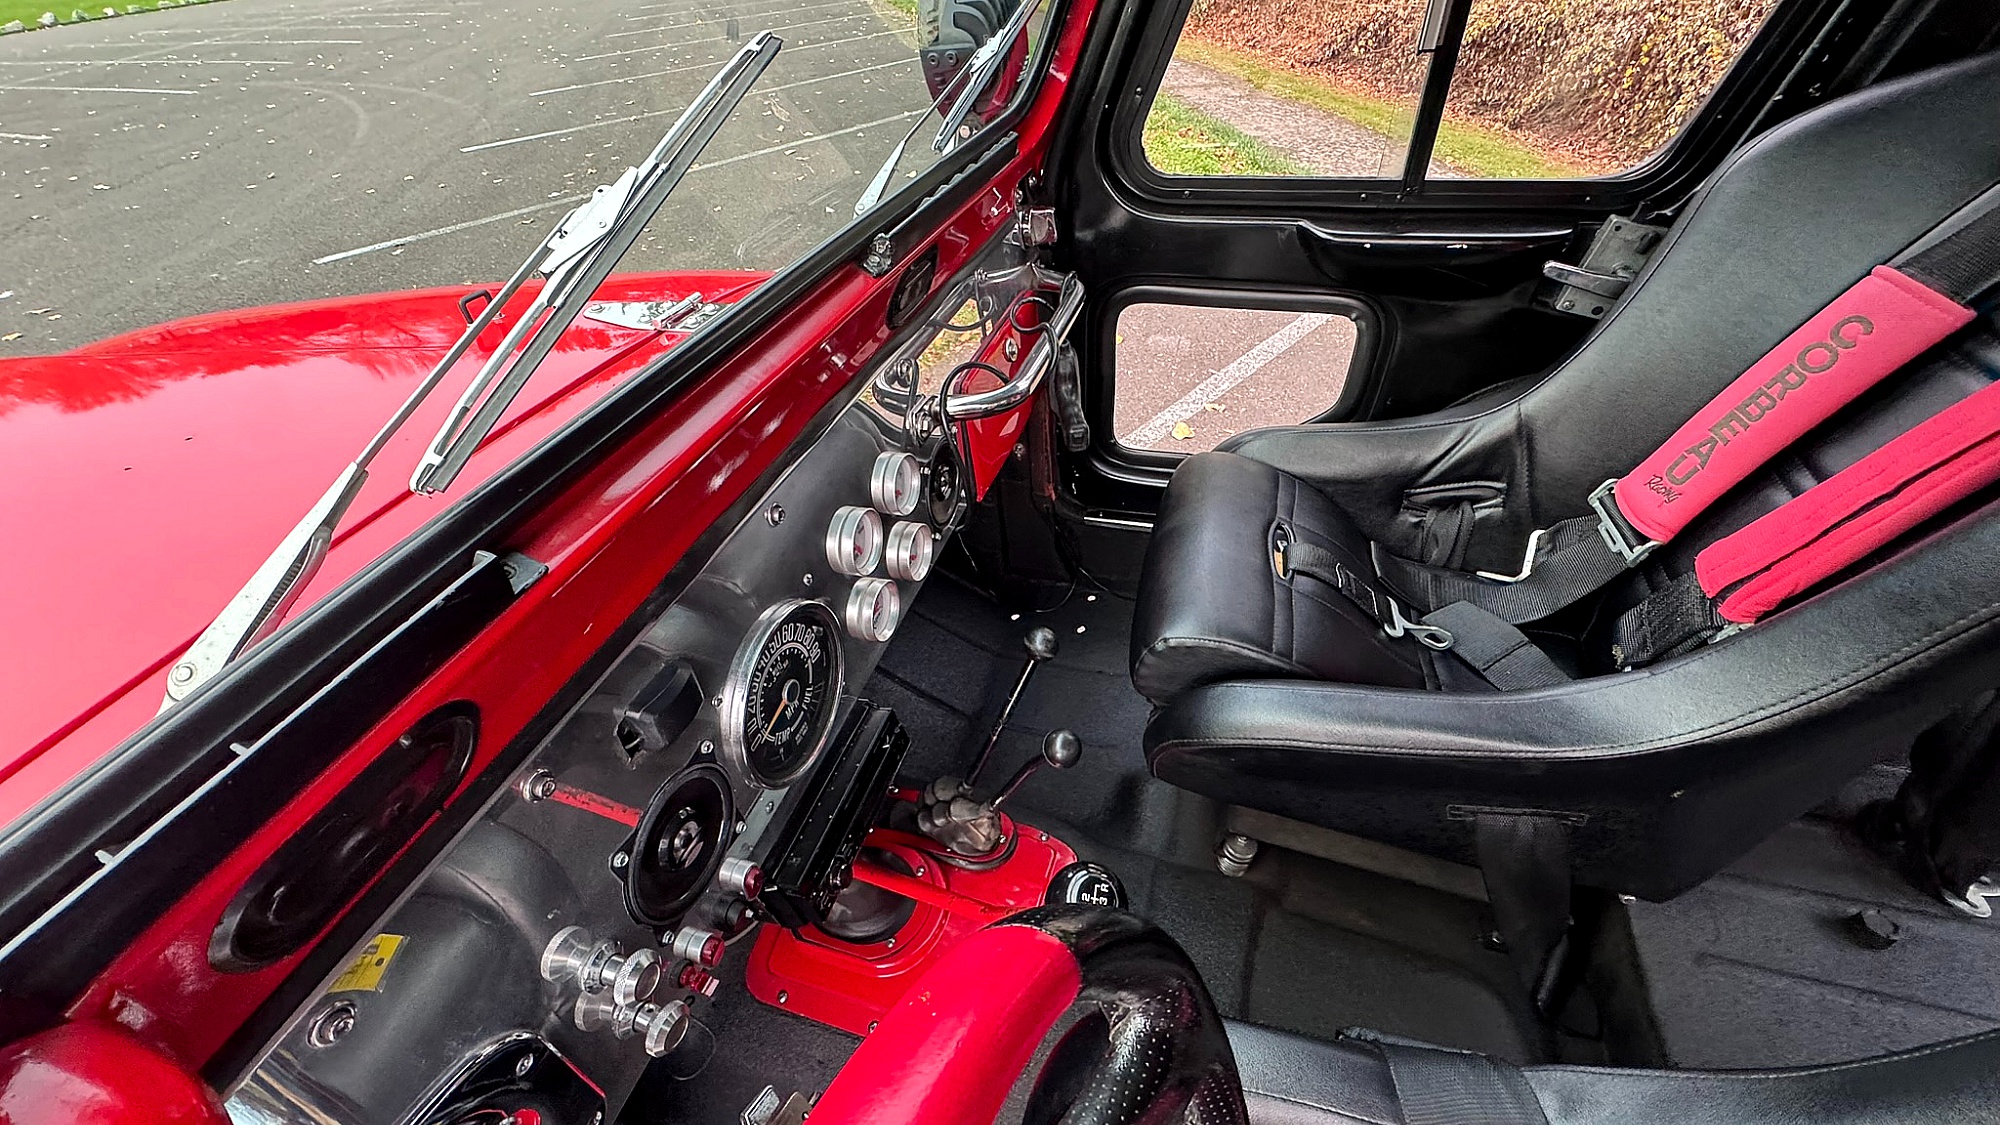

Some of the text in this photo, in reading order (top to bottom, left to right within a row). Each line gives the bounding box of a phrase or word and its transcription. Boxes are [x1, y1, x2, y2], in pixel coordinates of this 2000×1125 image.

[1664, 314, 1875, 486] CORBEAU
[782, 623, 794, 643] 60
[793, 623, 806, 642] 70
[802, 628, 815, 650] 80
[809, 641, 821, 664] 90
[801, 685, 814, 710] FUEL
[774, 726, 791, 746] TEMP
[1082, 893, 1090, 902] 2
[1101, 883, 1109, 892] R
[1099, 897, 1108, 905] 3
